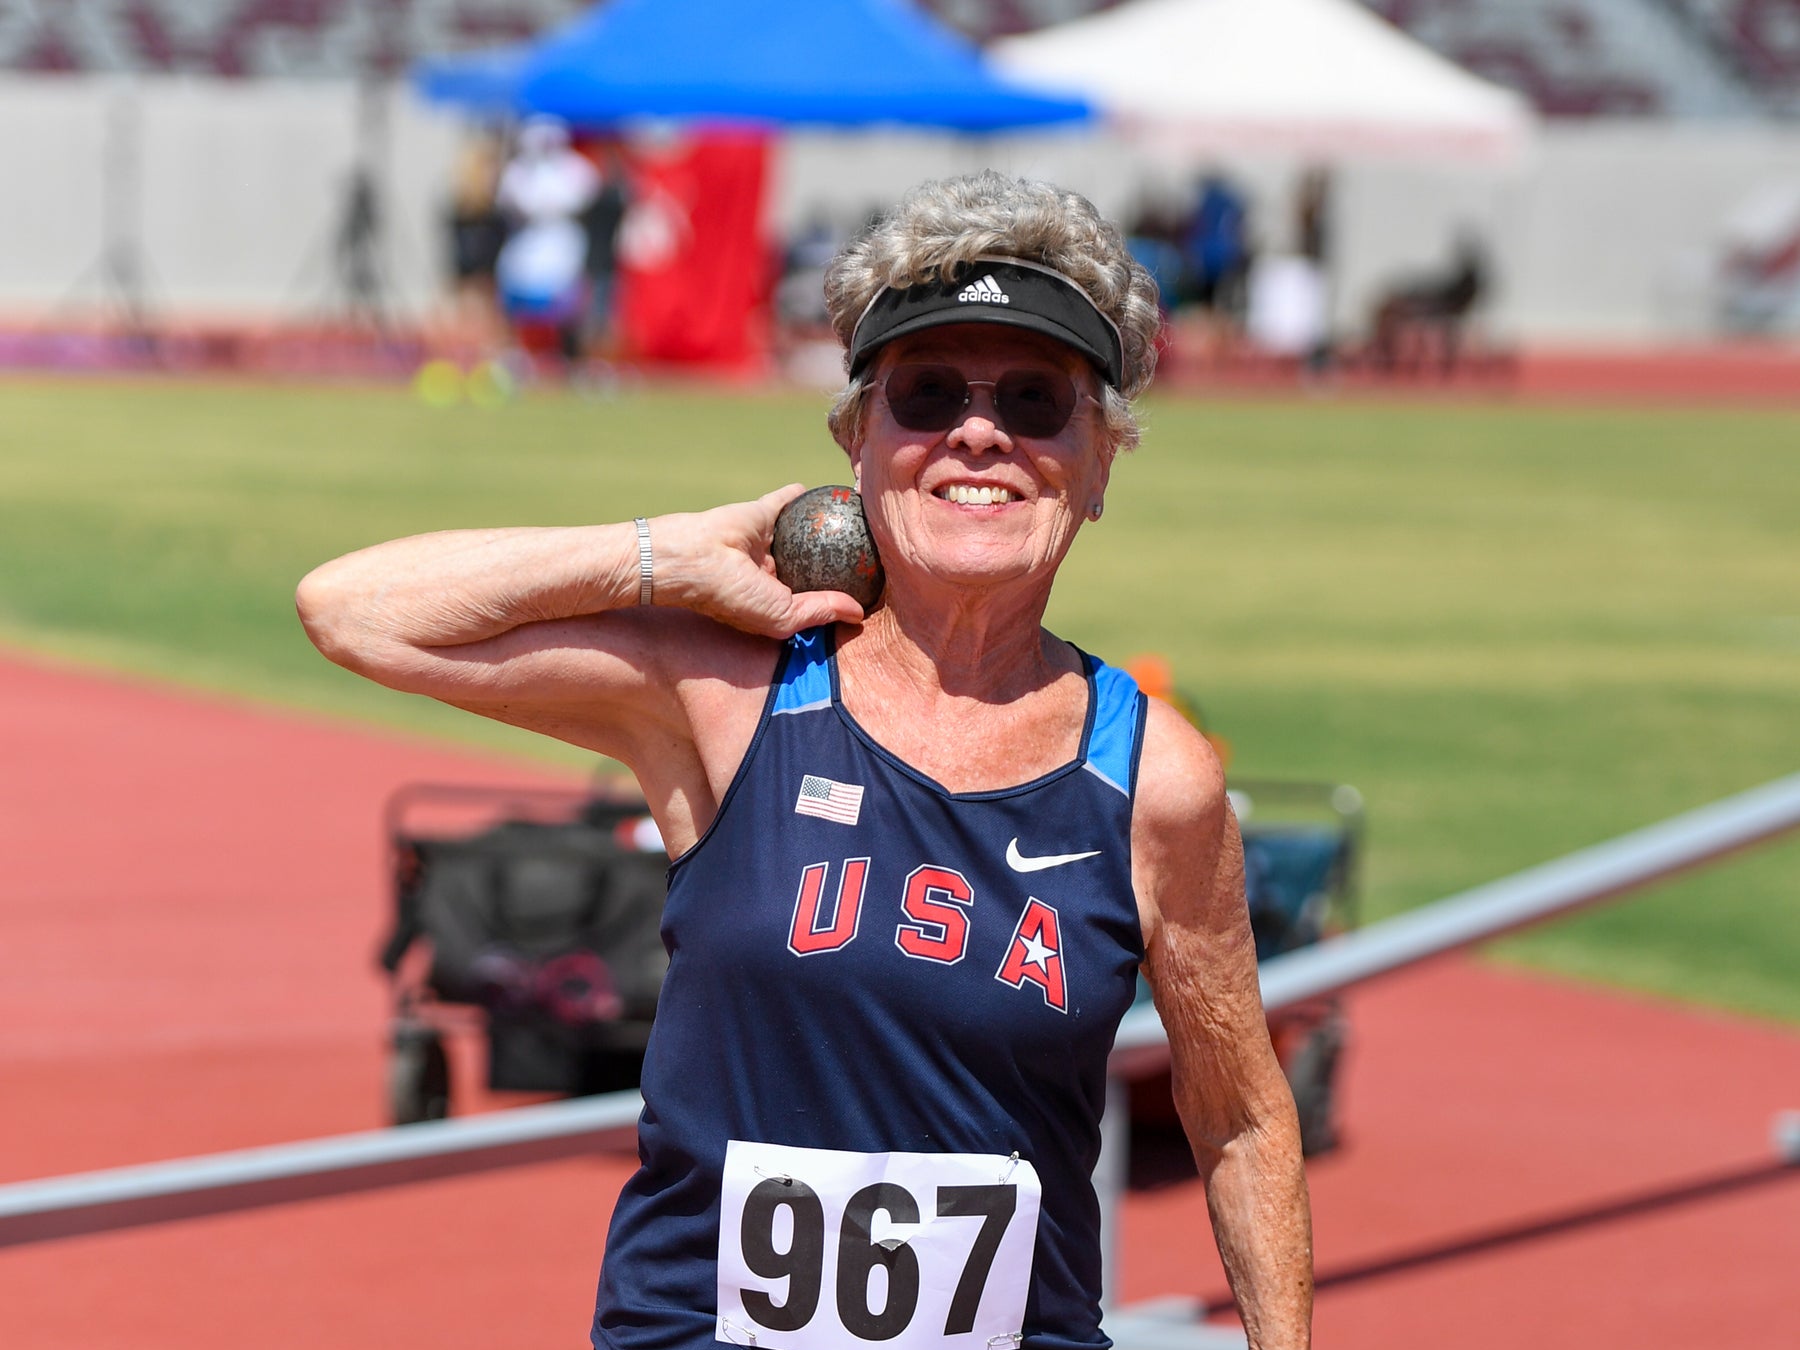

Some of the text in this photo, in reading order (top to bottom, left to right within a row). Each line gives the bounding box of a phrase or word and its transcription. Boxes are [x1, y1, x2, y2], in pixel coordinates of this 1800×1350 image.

[958, 290, 1010, 304] adidas
[787, 857, 1067, 1014] USA
[740, 1177, 1017, 1341] 967
